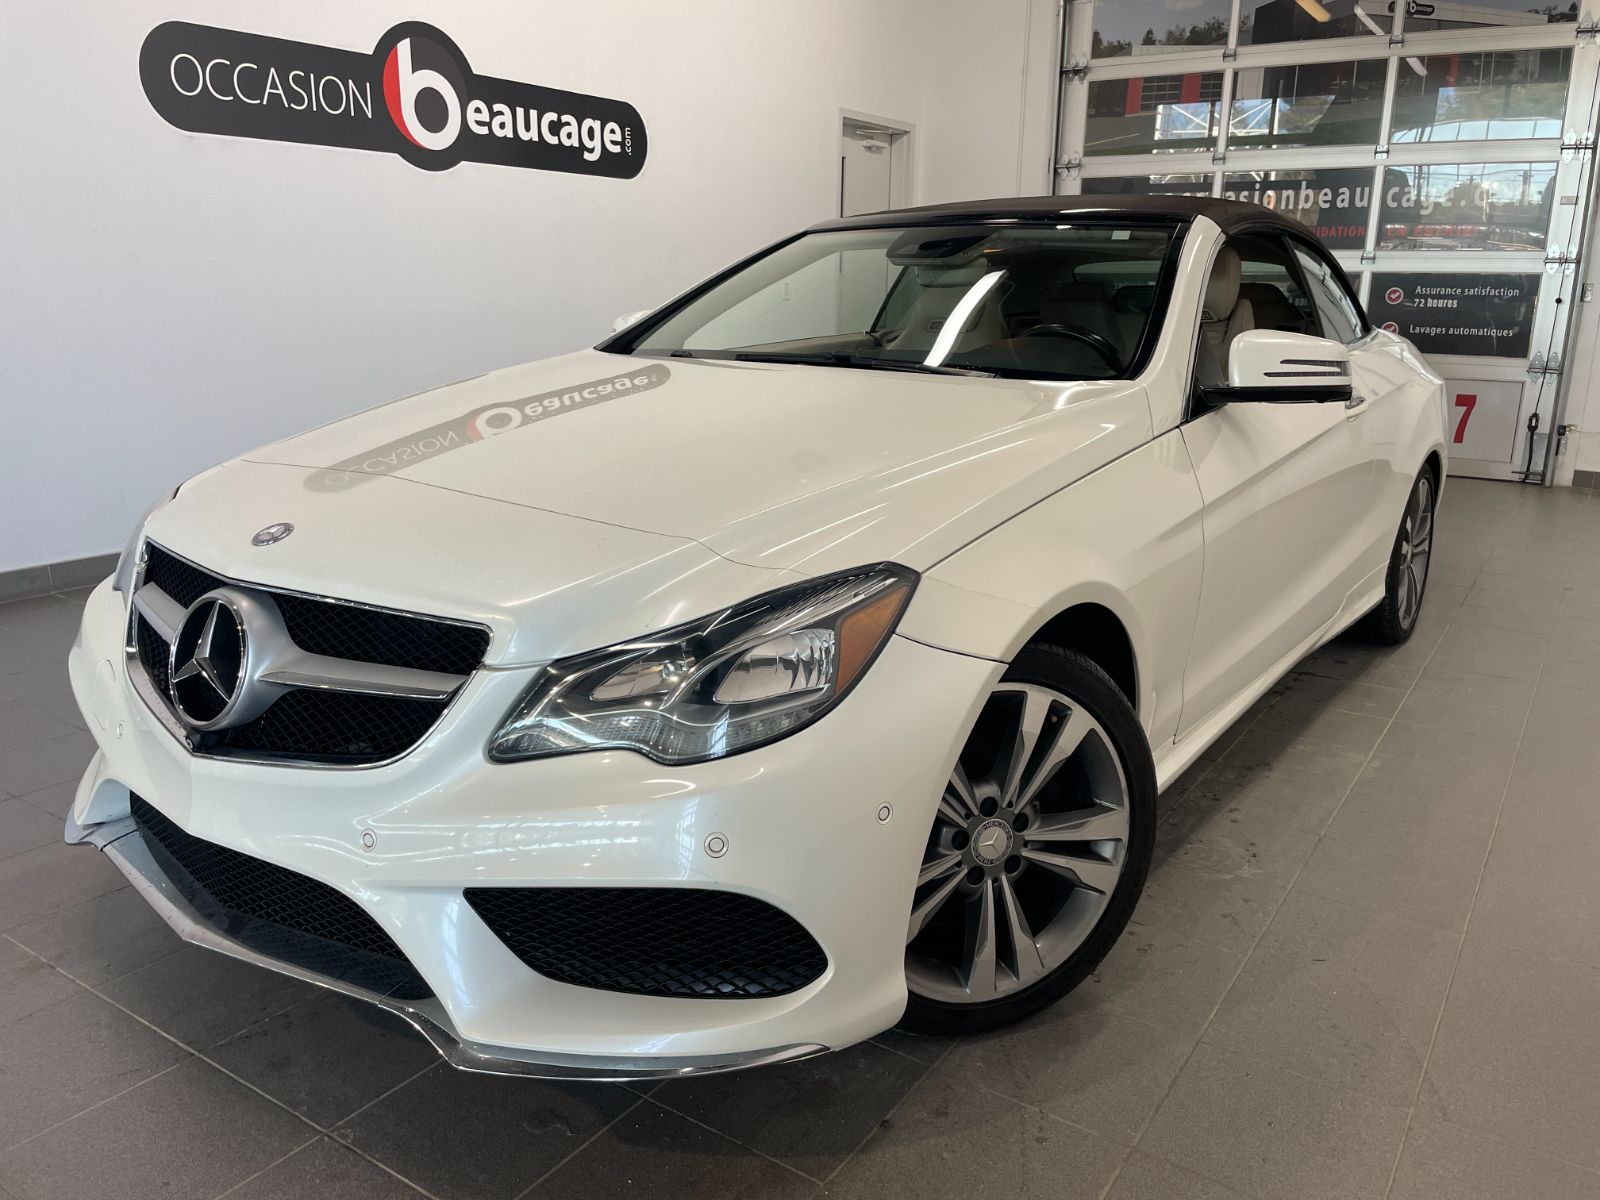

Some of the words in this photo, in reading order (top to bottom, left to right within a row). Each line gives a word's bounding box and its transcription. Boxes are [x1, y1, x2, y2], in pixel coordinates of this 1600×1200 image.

[170, 53, 372, 119] OCCASION
[397, 37, 622, 162] beaucage
[1415, 285, 1462, 295] Assurance
[1464, 286, 1520, 297] satisfaction
[1413, 299, 1425, 308] 72
[1427, 297, 1458, 308] heures
[1410, 324, 1446, 336] Lavages
[1448, 327, 1513, 338] automatiques
[1453, 394, 1477, 443] 7
